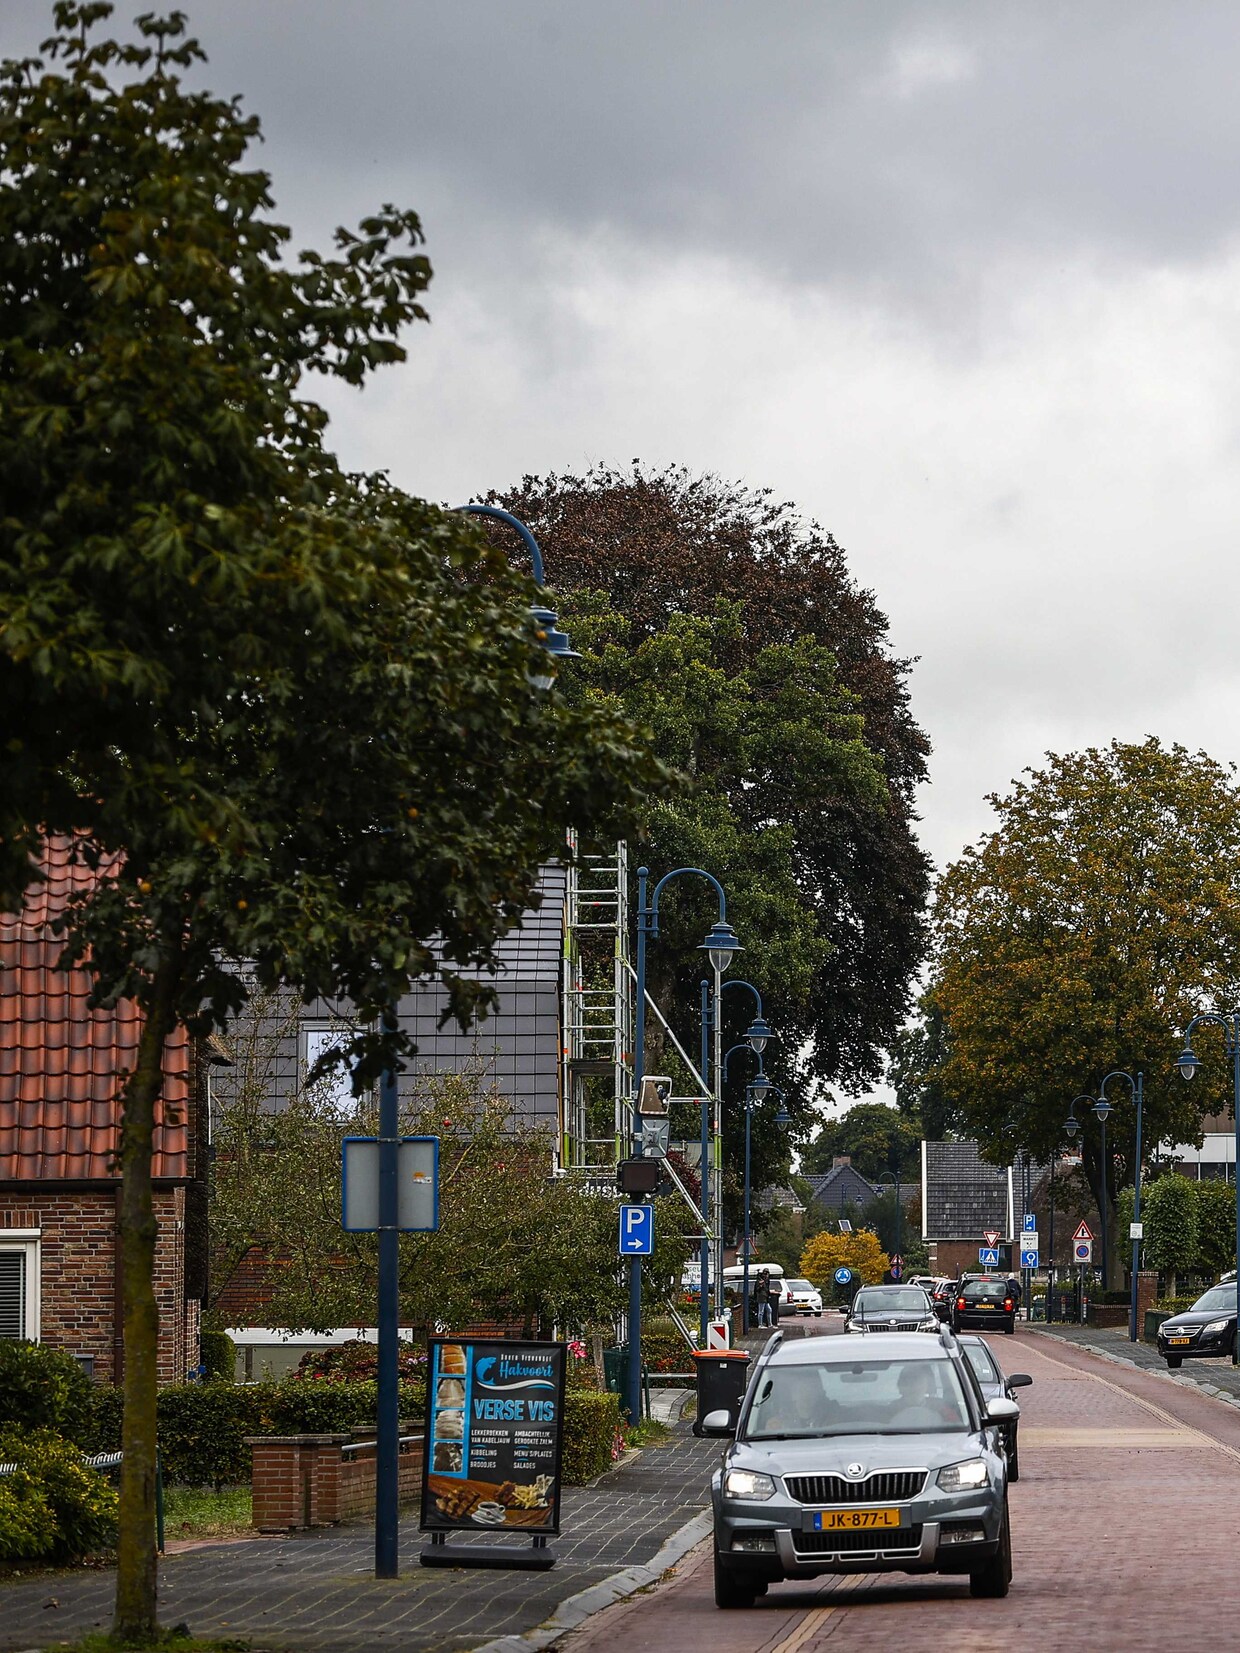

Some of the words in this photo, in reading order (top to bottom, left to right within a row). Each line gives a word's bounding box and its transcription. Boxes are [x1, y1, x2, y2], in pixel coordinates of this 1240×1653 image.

[627, 1208, 645, 1233] P
[1026, 1216, 1033, 1225] P
[499, 1361, 553, 1379] Hakvoort
[474, 1399, 525, 1420] VERSE
[528, 1400, 554, 1421] VIS
[828, 1512, 892, 1527] JK-877-L
